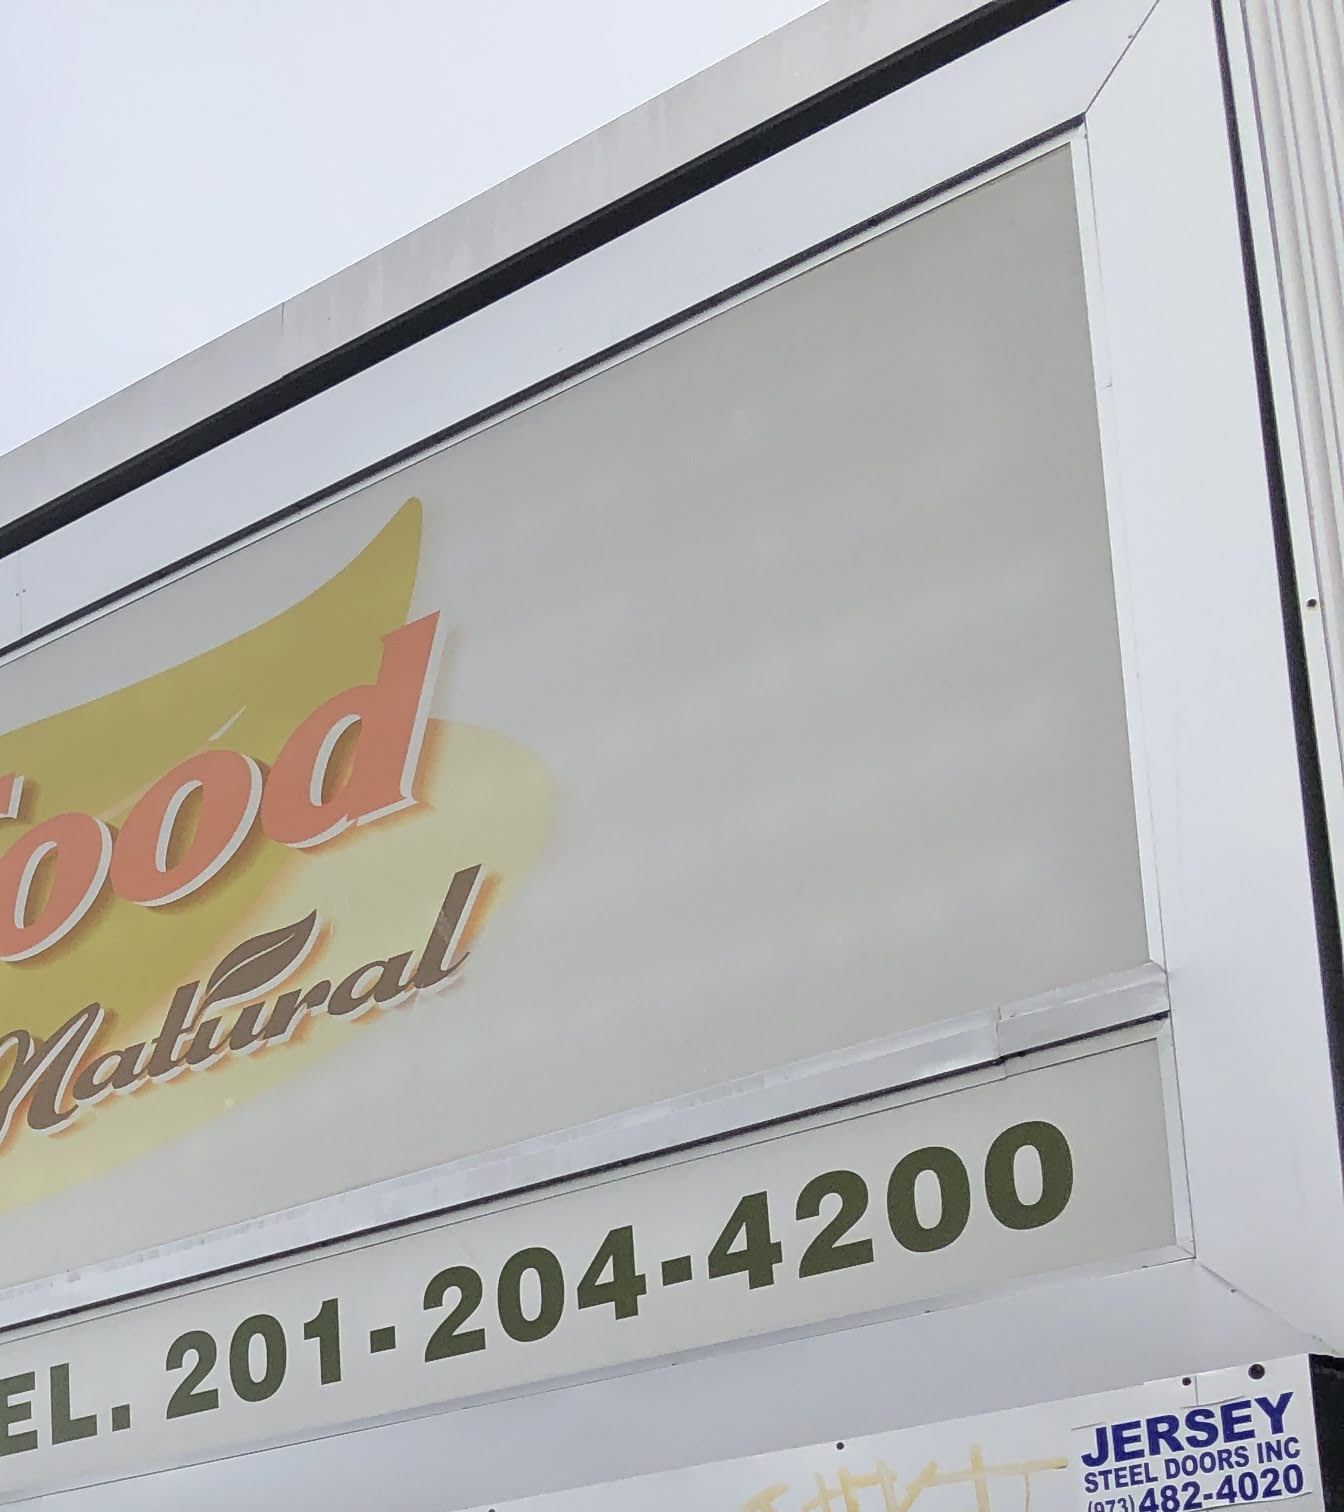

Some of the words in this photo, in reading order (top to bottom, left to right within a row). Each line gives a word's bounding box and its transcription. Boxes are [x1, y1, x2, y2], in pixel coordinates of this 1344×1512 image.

[167, 1120, 1075, 1420] 201-204-4200
[1081, 1392, 1294, 1467] JERSEY
[1084, 1462, 1158, 1493] STEEL
[1164, 1445, 1250, 1479] DOORS
[1257, 1436, 1301, 1464] INC
